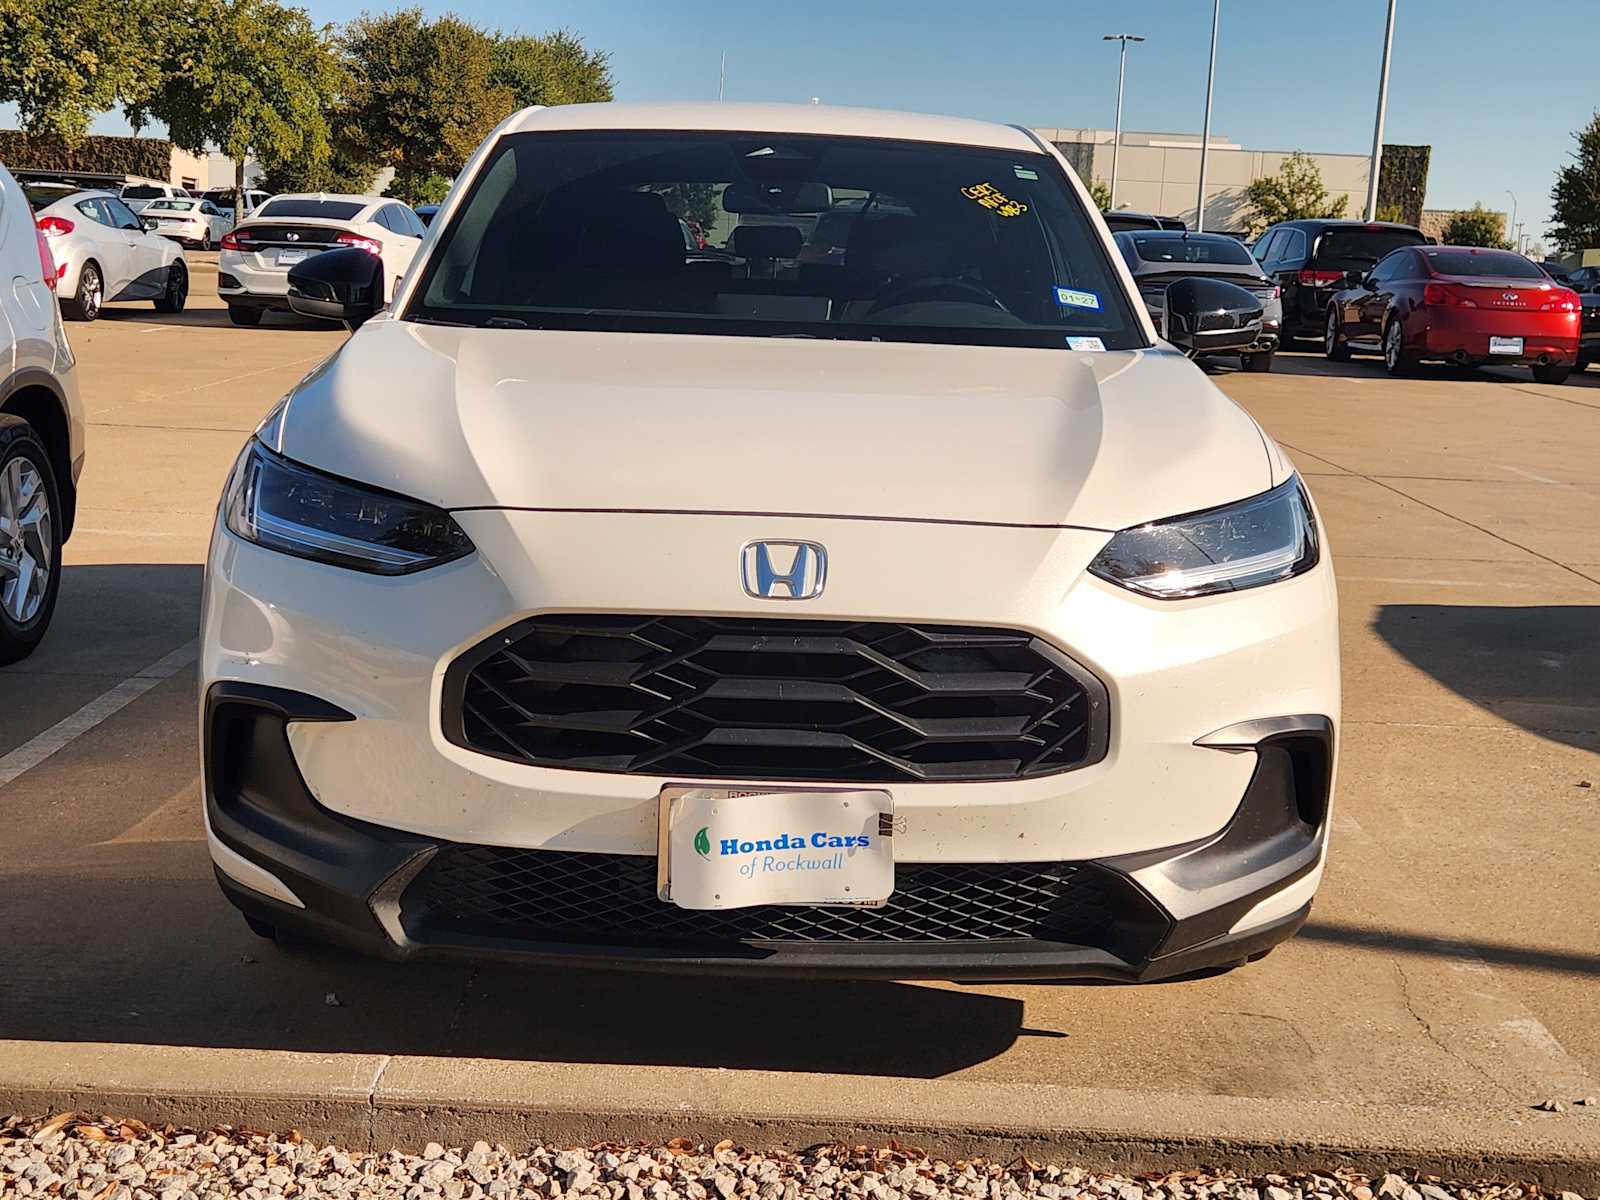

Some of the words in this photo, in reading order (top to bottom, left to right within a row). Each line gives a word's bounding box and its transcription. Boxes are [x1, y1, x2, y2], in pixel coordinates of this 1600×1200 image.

[1060, 293, 1096, 306] 01-27
[720, 833, 806, 856] Honda
[811, 832, 870, 849] Cars
[739, 856, 758, 879] of
[762, 852, 844, 872] Rockwall
